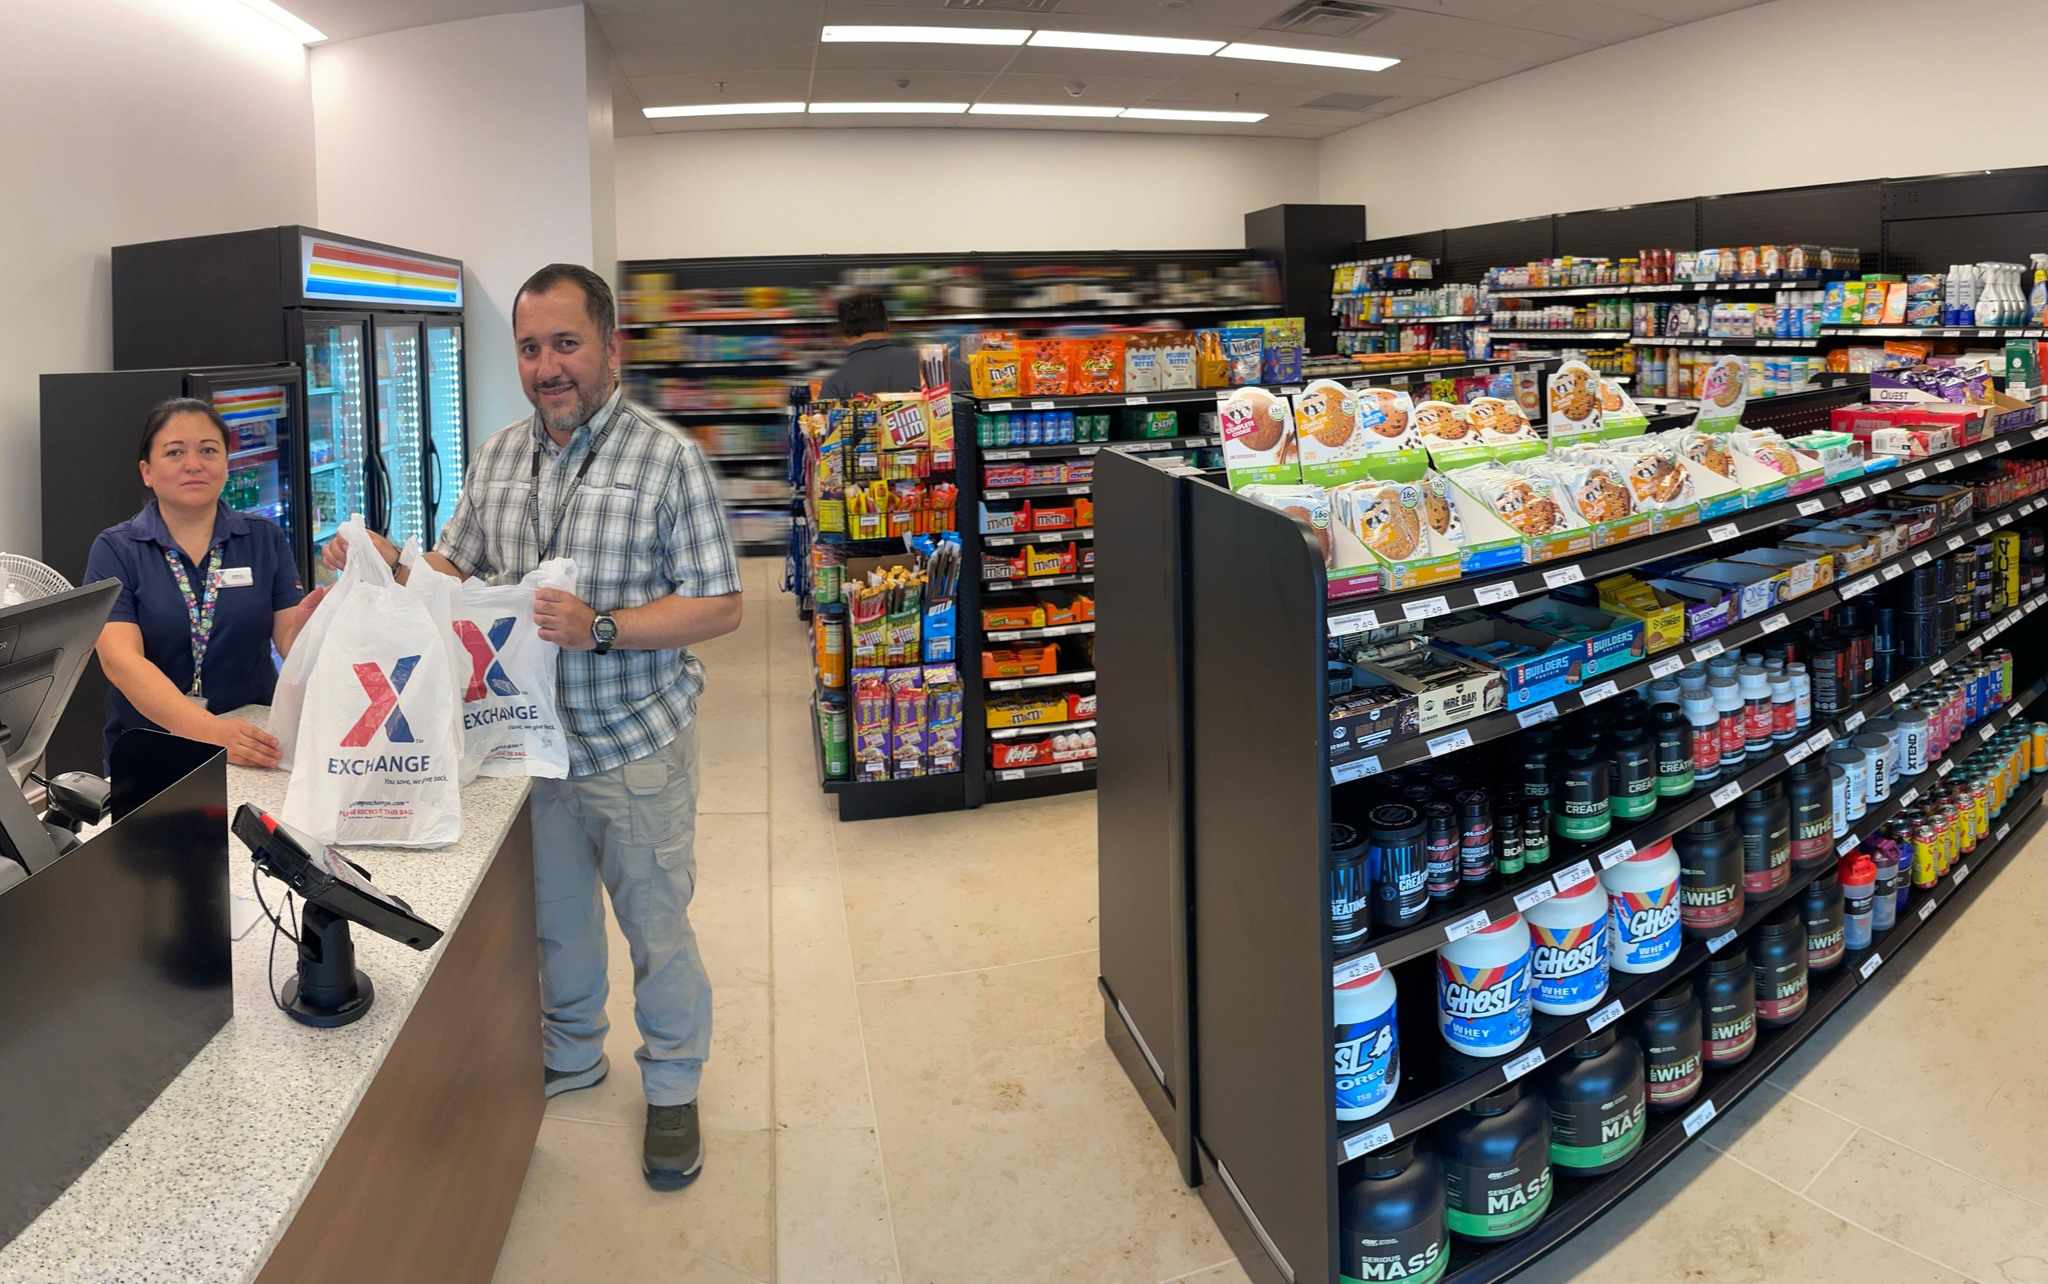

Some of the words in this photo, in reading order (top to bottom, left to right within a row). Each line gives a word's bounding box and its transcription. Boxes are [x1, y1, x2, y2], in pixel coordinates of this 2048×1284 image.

[886, 407, 921, 433] slim
[896, 420, 926, 446] jim
[1496, 590, 1513, 600] 2.49
[1424, 606, 1443, 617] 2.49
[1353, 620, 1374, 631] 2.49
[1593, 630, 1634, 653] BUILDERS
[1525, 656, 1570, 681] BUILDERS
[1461, 691, 1477, 705] BAR
[463, 705, 538, 730] EXCHANGE
[1908, 733, 1917, 770] XTEND
[327, 755, 430, 775] EXCHANGE
[1356, 766, 1377, 777] 2.49
[1875, 758, 1884, 797] XTEND
[1525, 787, 1549, 796] CREA
[1566, 798, 1609, 814] CREATINE
[1806, 817, 1832, 838] WHE
[1615, 847, 1634, 862] 59.99
[1571, 867, 1590, 881] 32.99
[1530, 890, 1551, 903] 10.79
[1687, 884, 1736, 906] WHEY
[1331, 896, 1367, 916] REATINE
[1465, 918, 1488, 935] 24.99
[1532, 926, 1606, 979] GHOST
[1638, 940, 1671, 955] WHEY
[1349, 963, 1375, 978] 42.99
[1445, 969, 1524, 1019] GHOST
[1540, 985, 1578, 995] WHEY
[1453, 1023, 1490, 1038] WHEY
[1521, 1055, 1543, 1071] 44.99
[1656, 1051, 1701, 1082] WHEY
[1335, 1068, 1386, 1091] OREO
[1363, 1133, 1388, 1150] 44.99
[1487, 1183, 1522, 1197] SERIOUS
[1487, 1167, 1550, 1214] MASS
[1361, 1255, 1401, 1263] SERIOUS
[1361, 1242, 1439, 1281] MASS
